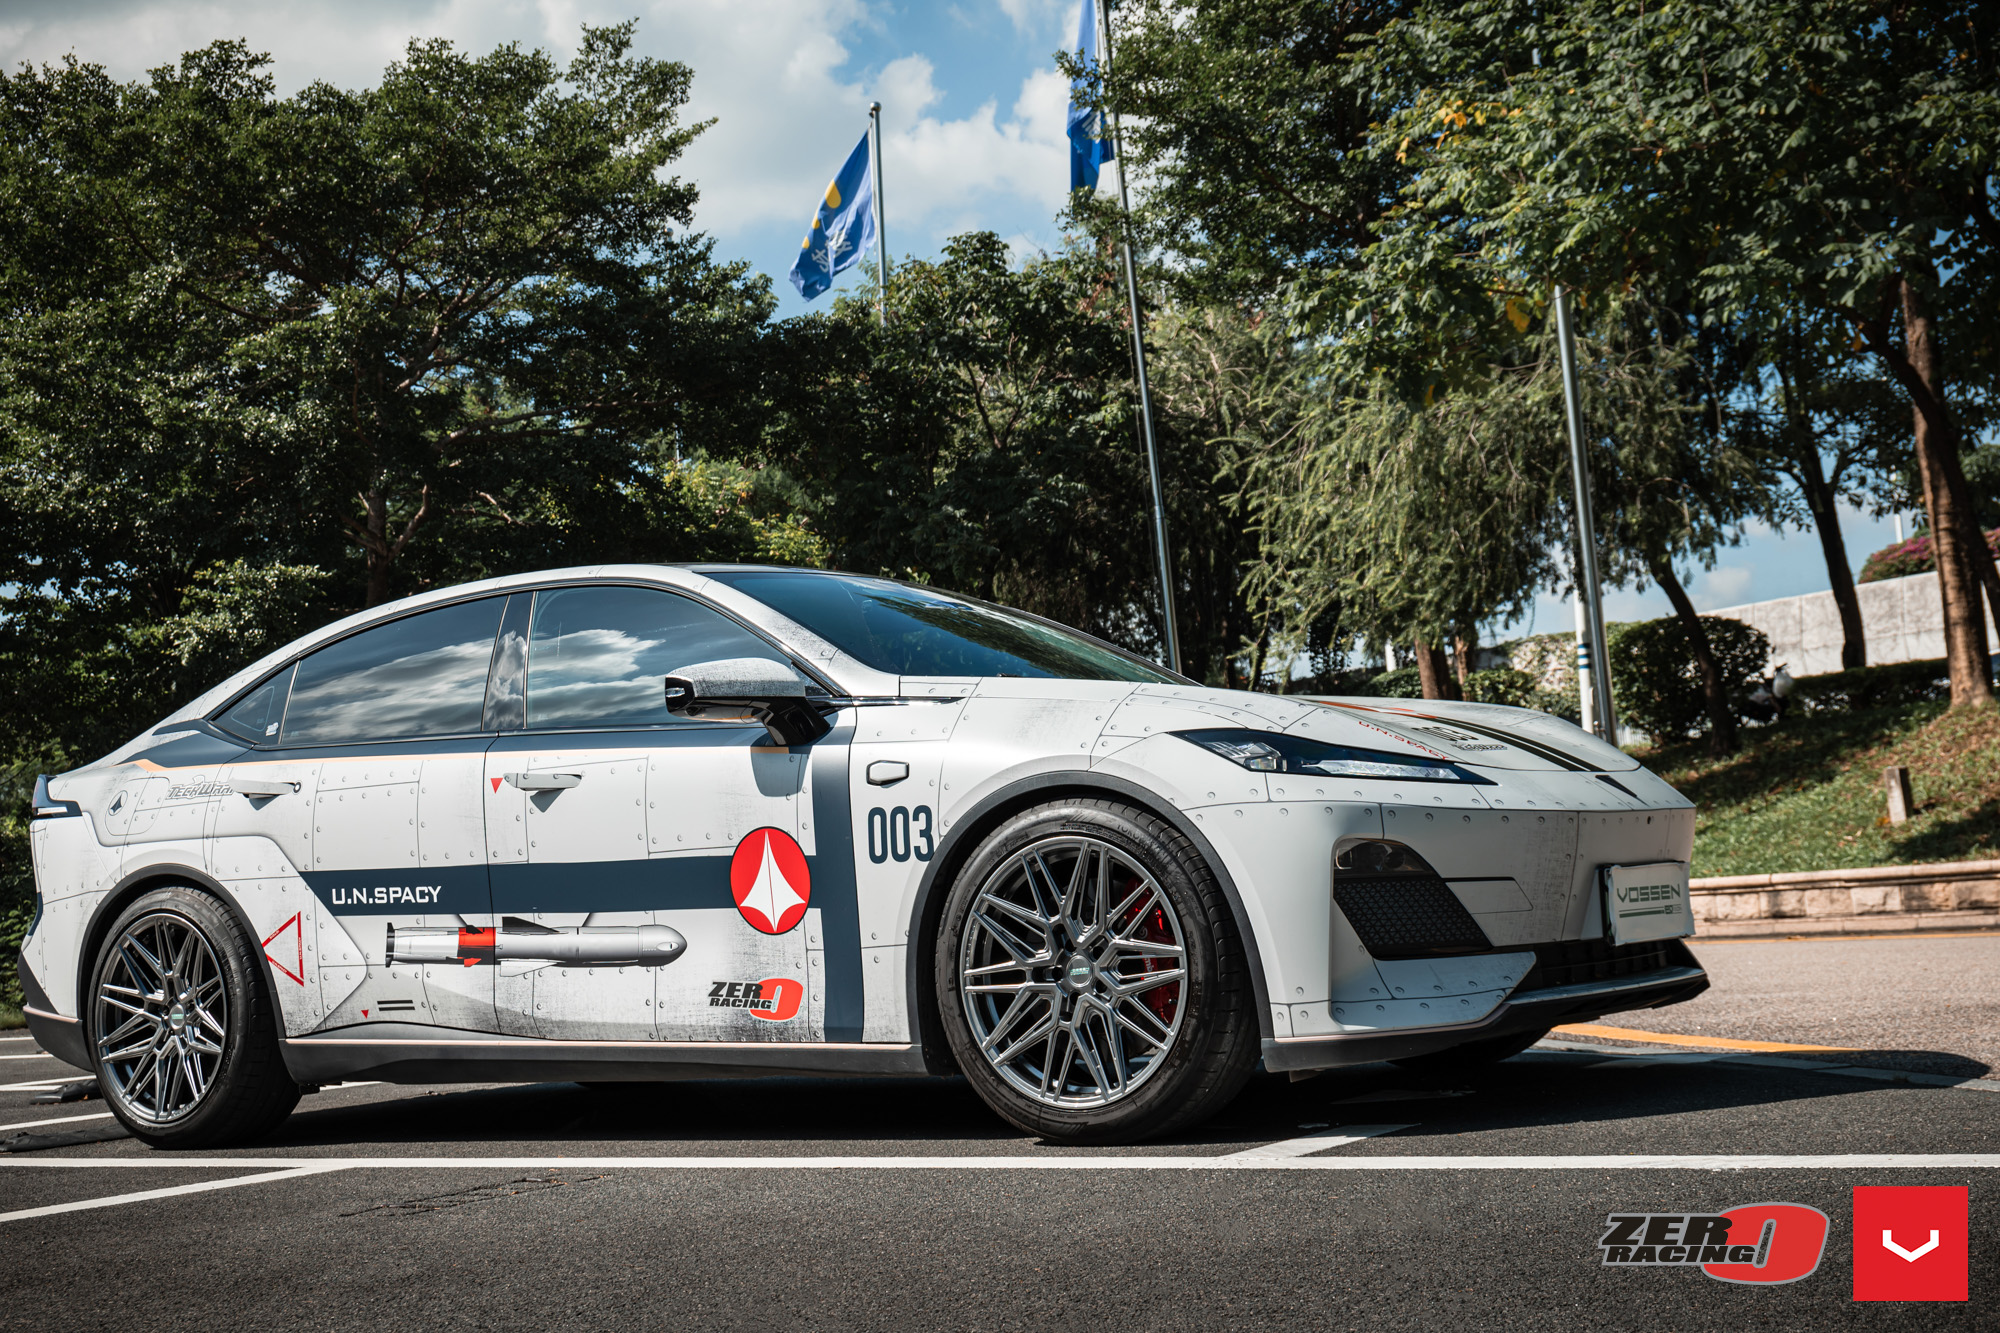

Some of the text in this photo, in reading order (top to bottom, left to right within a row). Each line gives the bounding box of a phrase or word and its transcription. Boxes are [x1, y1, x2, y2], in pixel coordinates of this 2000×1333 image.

[868, 805, 934, 864] 003
[332, 886, 442, 905] U.N.SPACY
[1616, 884, 1681, 903] VOSSEN
[709, 997, 773, 1010] RACING
